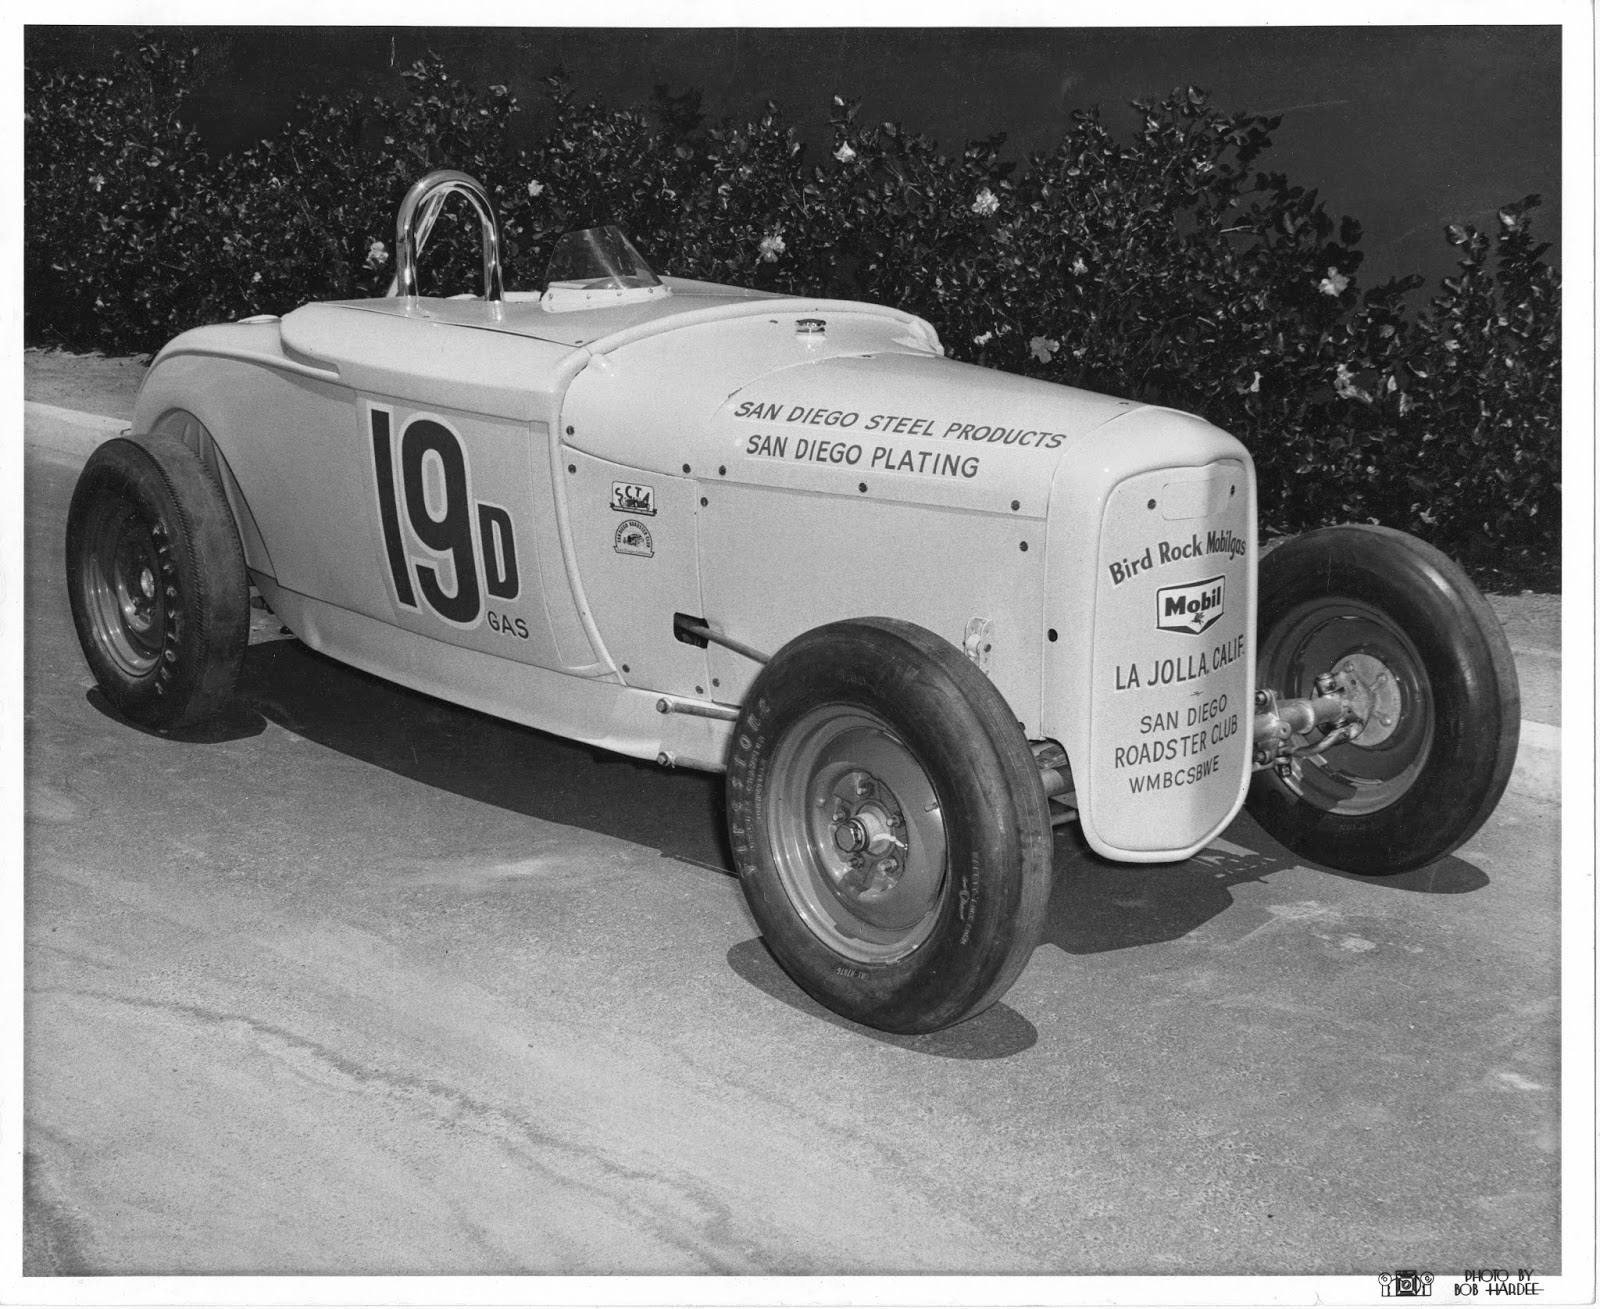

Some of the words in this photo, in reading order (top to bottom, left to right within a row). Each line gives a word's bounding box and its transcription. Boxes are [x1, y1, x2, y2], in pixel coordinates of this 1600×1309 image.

[734, 401, 784, 421] SAN
[786, 405, 860, 428] DIEGO
[864, 414, 936, 437] STEEL
[942, 421, 1067, 449] PRODUCTS
[746, 434, 789, 458] SAN
[794, 437, 862, 465] DIEGO
[871, 446, 980, 479] PLATING
[1108, 547, 1153, 586] Bird
[1158, 533, 1203, 565] Rock
[1206, 529, 1246, 561] Mobilgas
[1164, 586, 1222, 617] Mobil
[487, 610, 530, 640] GAS
[1115, 663, 1141, 690] LA
[1212, 634, 1246, 670] CALIF.
[1140, 710, 1179, 734] SAN
[1187, 693, 1228, 727] DIEGO
[1114, 730, 1207, 769] ROADSTER
[1211, 714, 1238, 745] CLUB
[1128, 754, 1220, 794] WMBCSBWE
